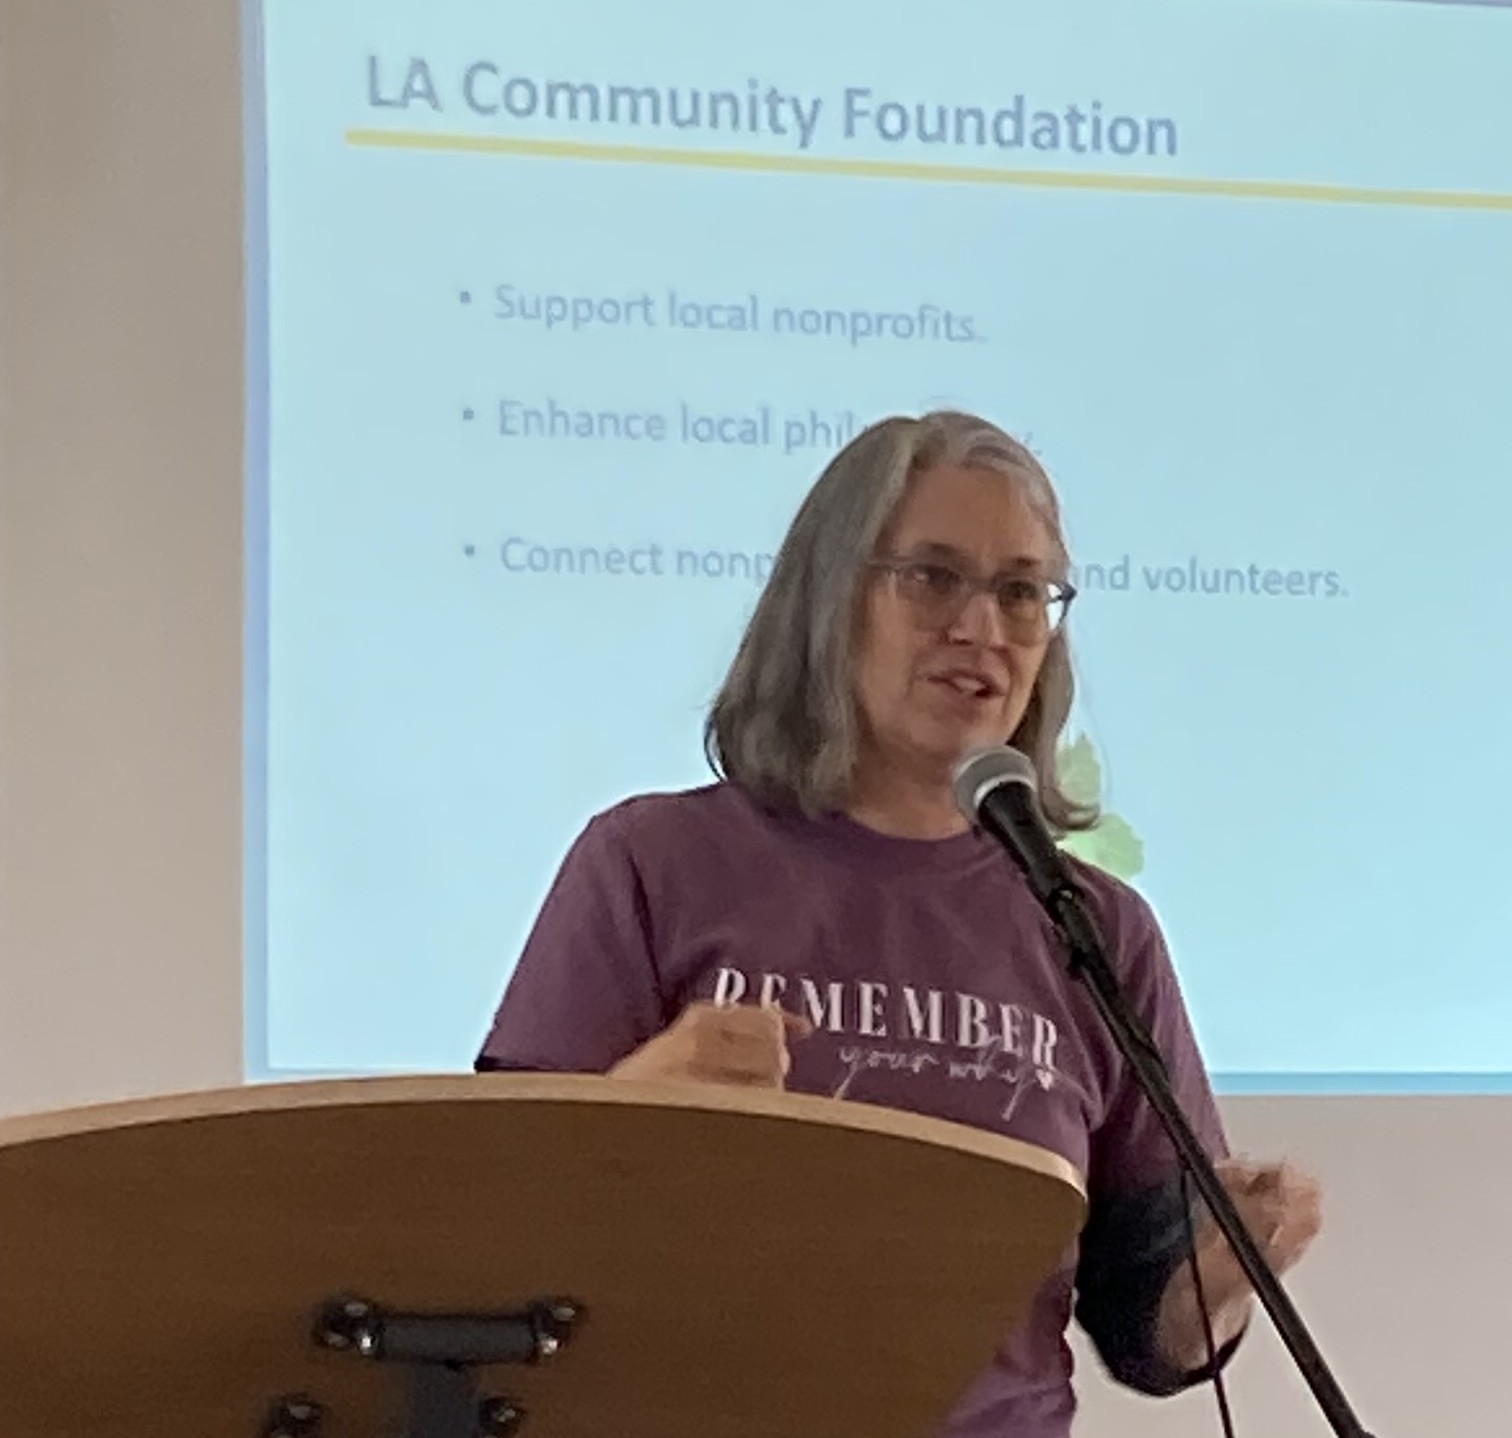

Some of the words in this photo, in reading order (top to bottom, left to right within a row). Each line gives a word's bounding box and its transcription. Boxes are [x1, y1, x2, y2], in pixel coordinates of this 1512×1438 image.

[368, 55, 442, 112] LA
[463, 60, 822, 150] Community
[843, 86, 1178, 157] Foundation
[494, 284, 655, 331] Support
[667, 289, 760, 333] local
[499, 399, 666, 441] Enhance
[680, 402, 770, 445] local
[501, 537, 664, 577] Connect
[714, 966, 1058, 1069] REMEMBER
[833, 1046, 939, 1100] your
